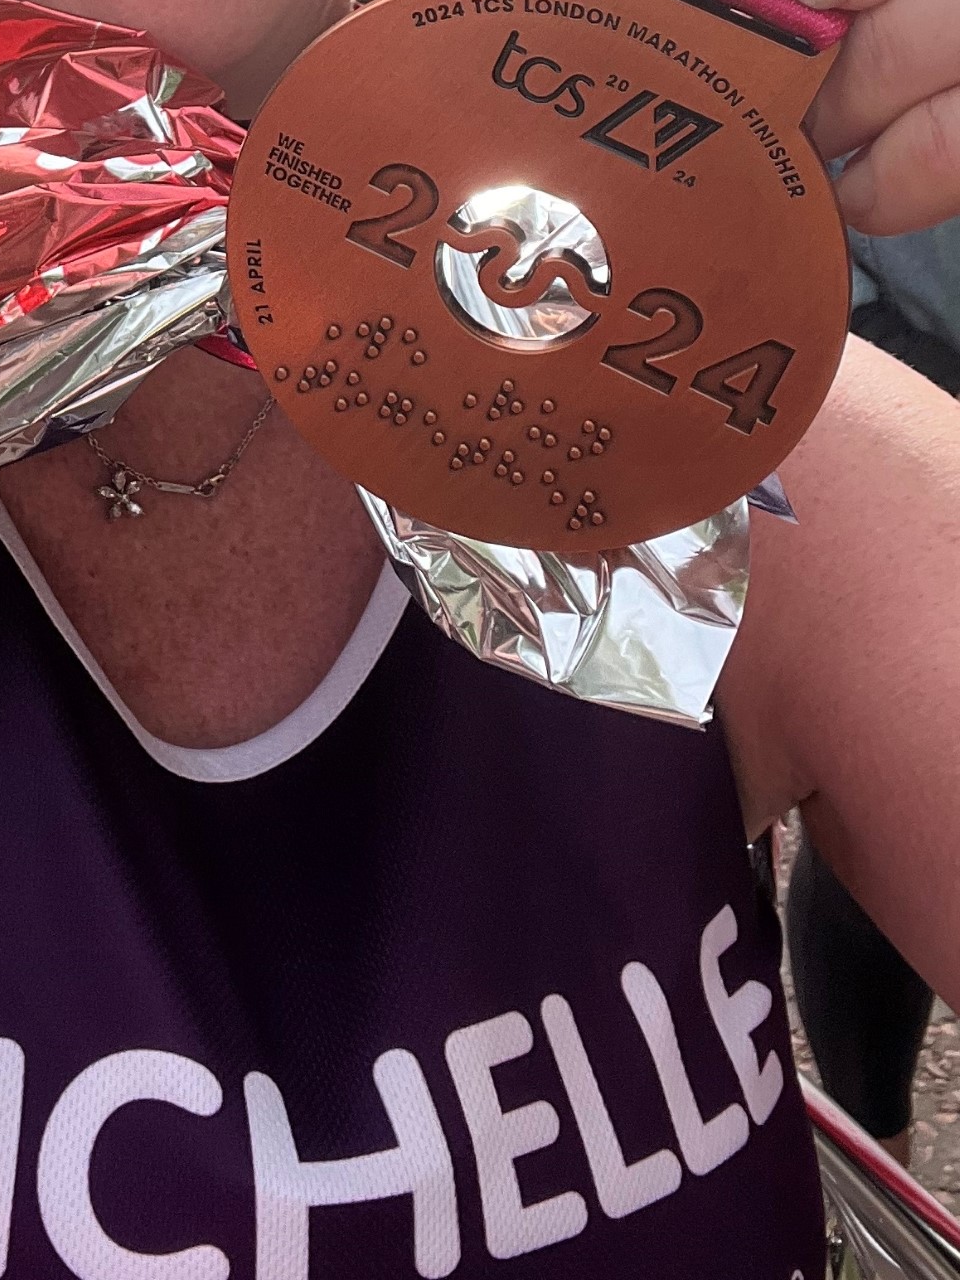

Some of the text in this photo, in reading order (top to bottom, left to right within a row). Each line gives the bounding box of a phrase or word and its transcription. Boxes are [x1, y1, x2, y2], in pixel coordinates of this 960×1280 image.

[491, 29, 596, 119] tcs
[605, 74, 630, 93] 20
[411, 1, 465, 27] 2024
[626, 21, 746, 108] MARATHON
[742, 108, 806, 199] FINISHER
[278, 132, 306, 157] WE
[264, 161, 353, 214] TOGETHER
[268, 147, 344, 191] FINISHED
[672, 170, 697, 188] 24
[246, 238, 274, 326] 21 APRIL
